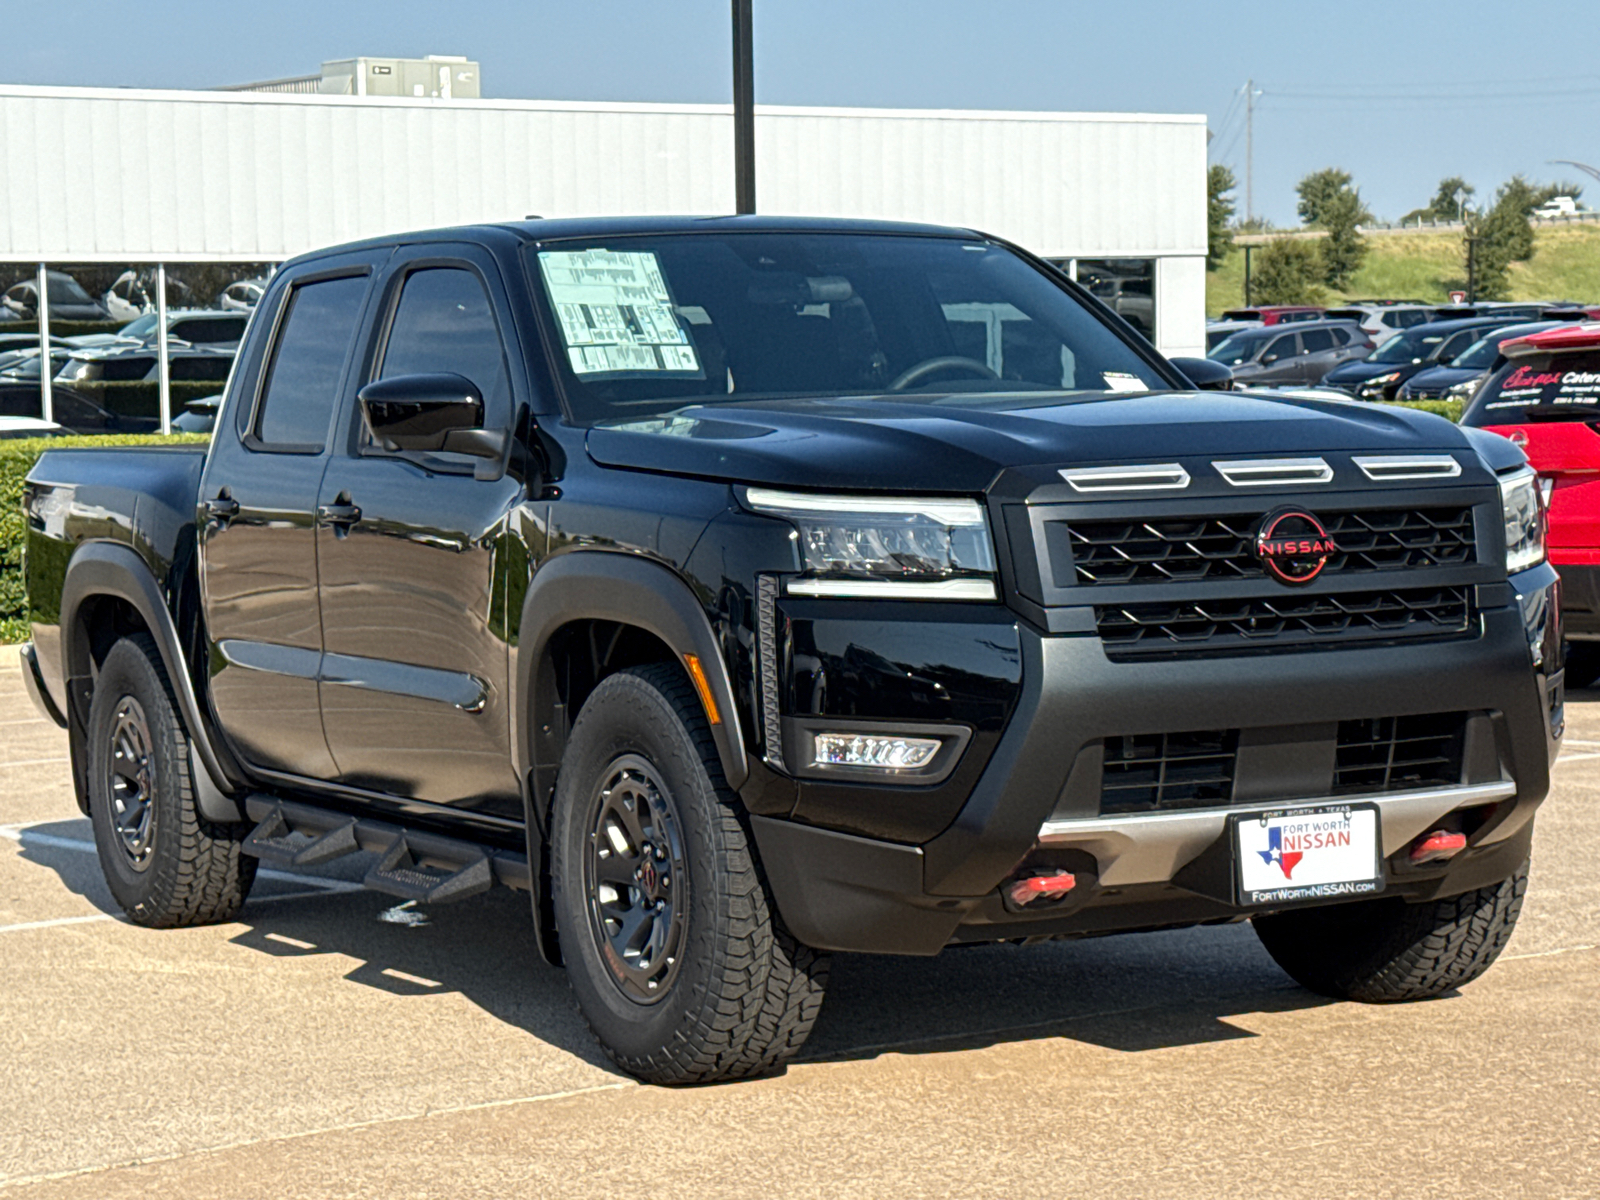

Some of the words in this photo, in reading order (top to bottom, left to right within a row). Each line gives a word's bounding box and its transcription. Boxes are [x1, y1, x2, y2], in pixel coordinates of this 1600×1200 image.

[1259, 541, 1334, 556] NISSAN
[1262, 810, 1283, 819] FORT
[1286, 808, 1315, 817] WORTH
[1325, 805, 1351, 813] TEXAS
[1283, 823, 1310, 835] FORT
[1312, 820, 1351, 832] WORTH
[1283, 830, 1351, 851] NISSAN
